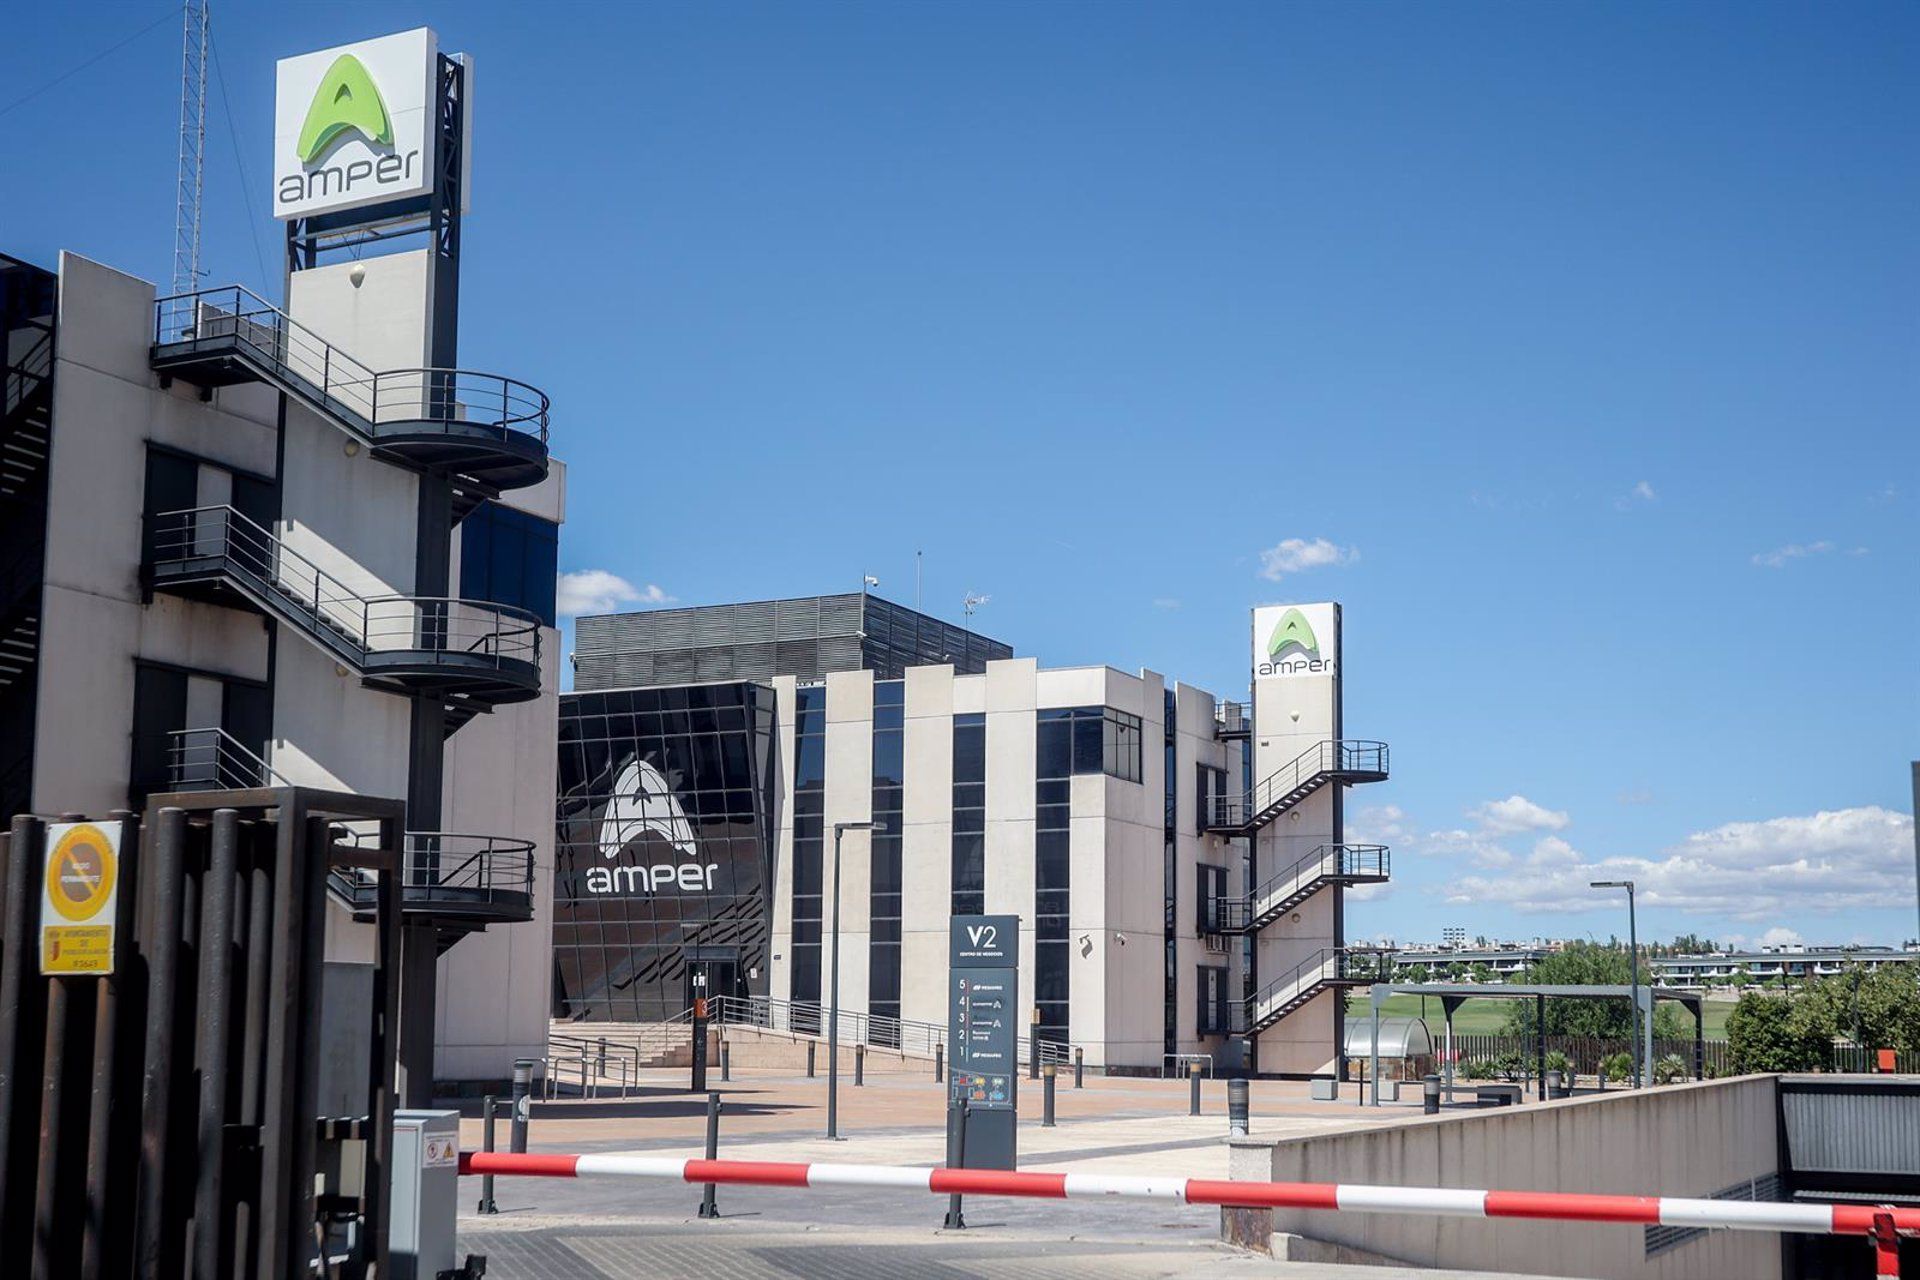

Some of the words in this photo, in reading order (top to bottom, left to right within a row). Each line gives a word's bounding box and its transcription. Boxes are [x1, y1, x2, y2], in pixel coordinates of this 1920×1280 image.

[279, 150, 419, 203] amper
[1259, 659, 1331, 675] amper
[586, 863, 718, 893] amper
[966, 925, 997, 948] V2
[959, 979, 966, 990] 5
[959, 996, 966, 1006] 4
[959, 1013, 966, 1023] 3
[958, 1029, 965, 1040] 2
